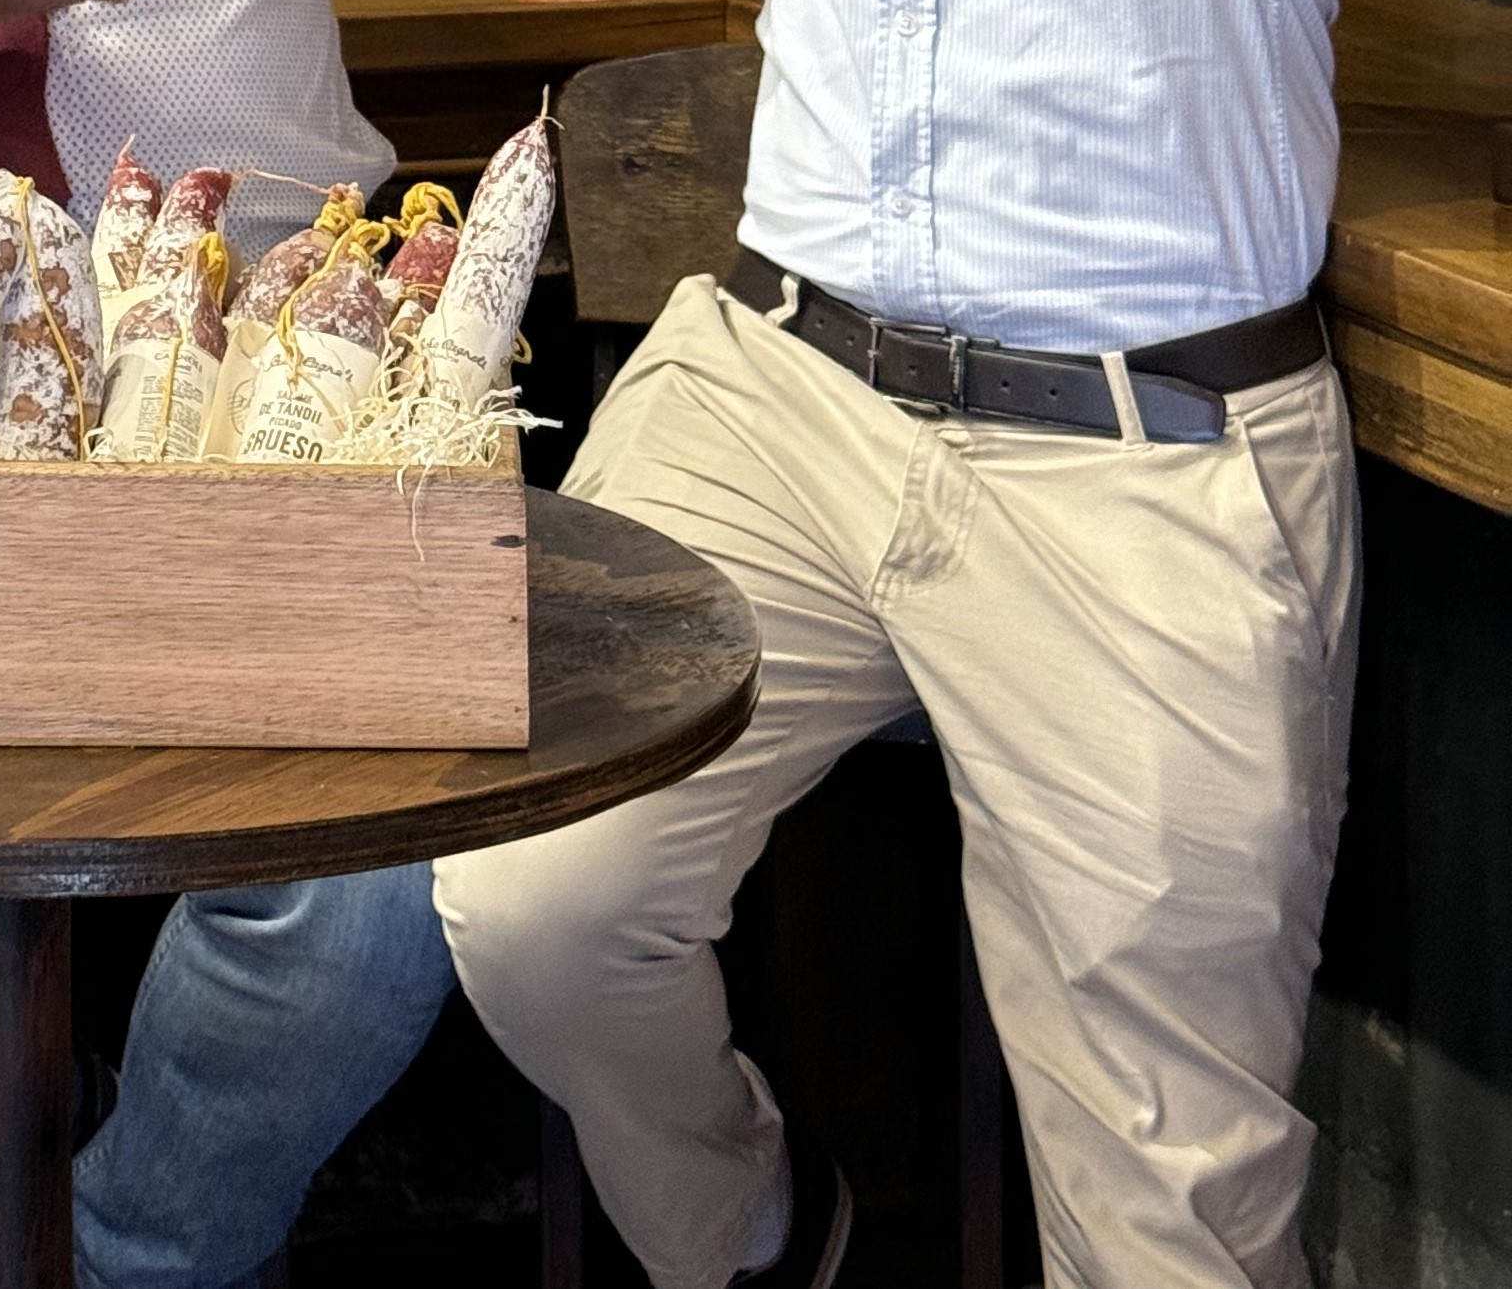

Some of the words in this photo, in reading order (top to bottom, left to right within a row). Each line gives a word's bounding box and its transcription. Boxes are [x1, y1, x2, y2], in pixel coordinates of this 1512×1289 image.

[258, 401, 275, 417] DE
[277, 401, 324, 427] TANDIL
[269, 416, 303, 430] PICADO
[242, 429, 324, 463] GRUESO
